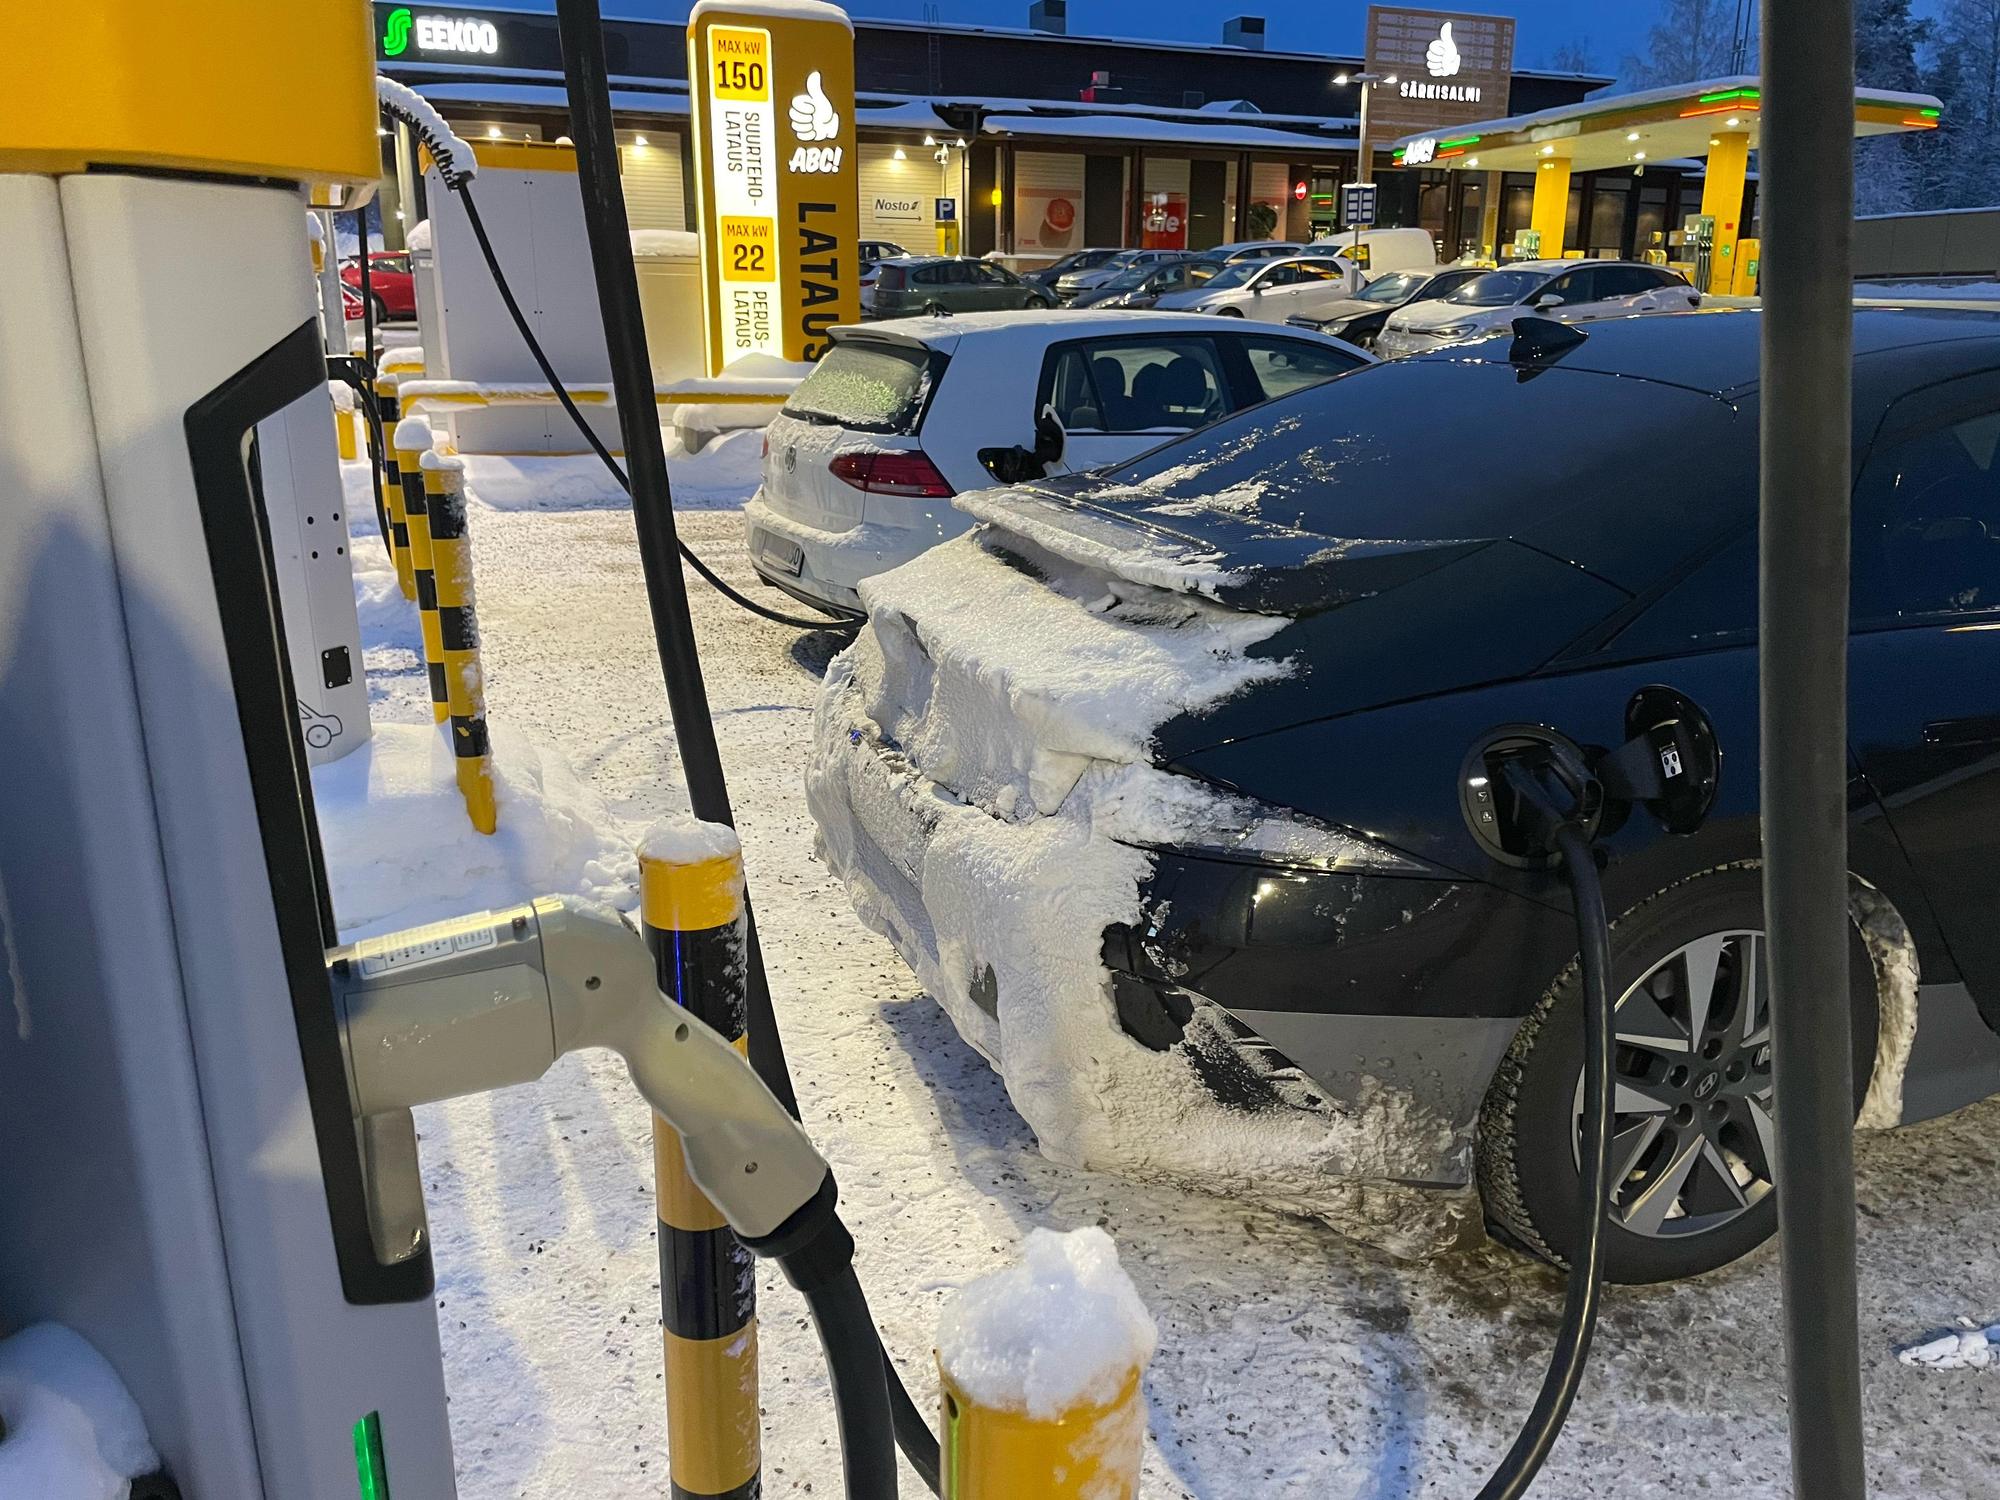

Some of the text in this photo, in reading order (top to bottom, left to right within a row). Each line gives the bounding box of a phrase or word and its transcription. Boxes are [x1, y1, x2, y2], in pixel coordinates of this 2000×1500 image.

[416, 18, 498, 54] EEKOO
[718, 39, 760, 55] MAX kW
[718, 60, 764, 91] 150
[1400, 80, 1481, 102] SÄRKISALMI
[725, 111, 743, 172] LATAUS
[744, 111, 763, 206] SUURTEHO-
[788, 145, 842, 173] ABC!
[875, 199, 910, 211] Nosto
[939, 200, 953, 219] P
[727, 223, 768, 237] MAX kW
[733, 244, 765, 272] 22
[734, 290, 751, 348] LATAUS
[752, 291, 769, 348] PERUS-
